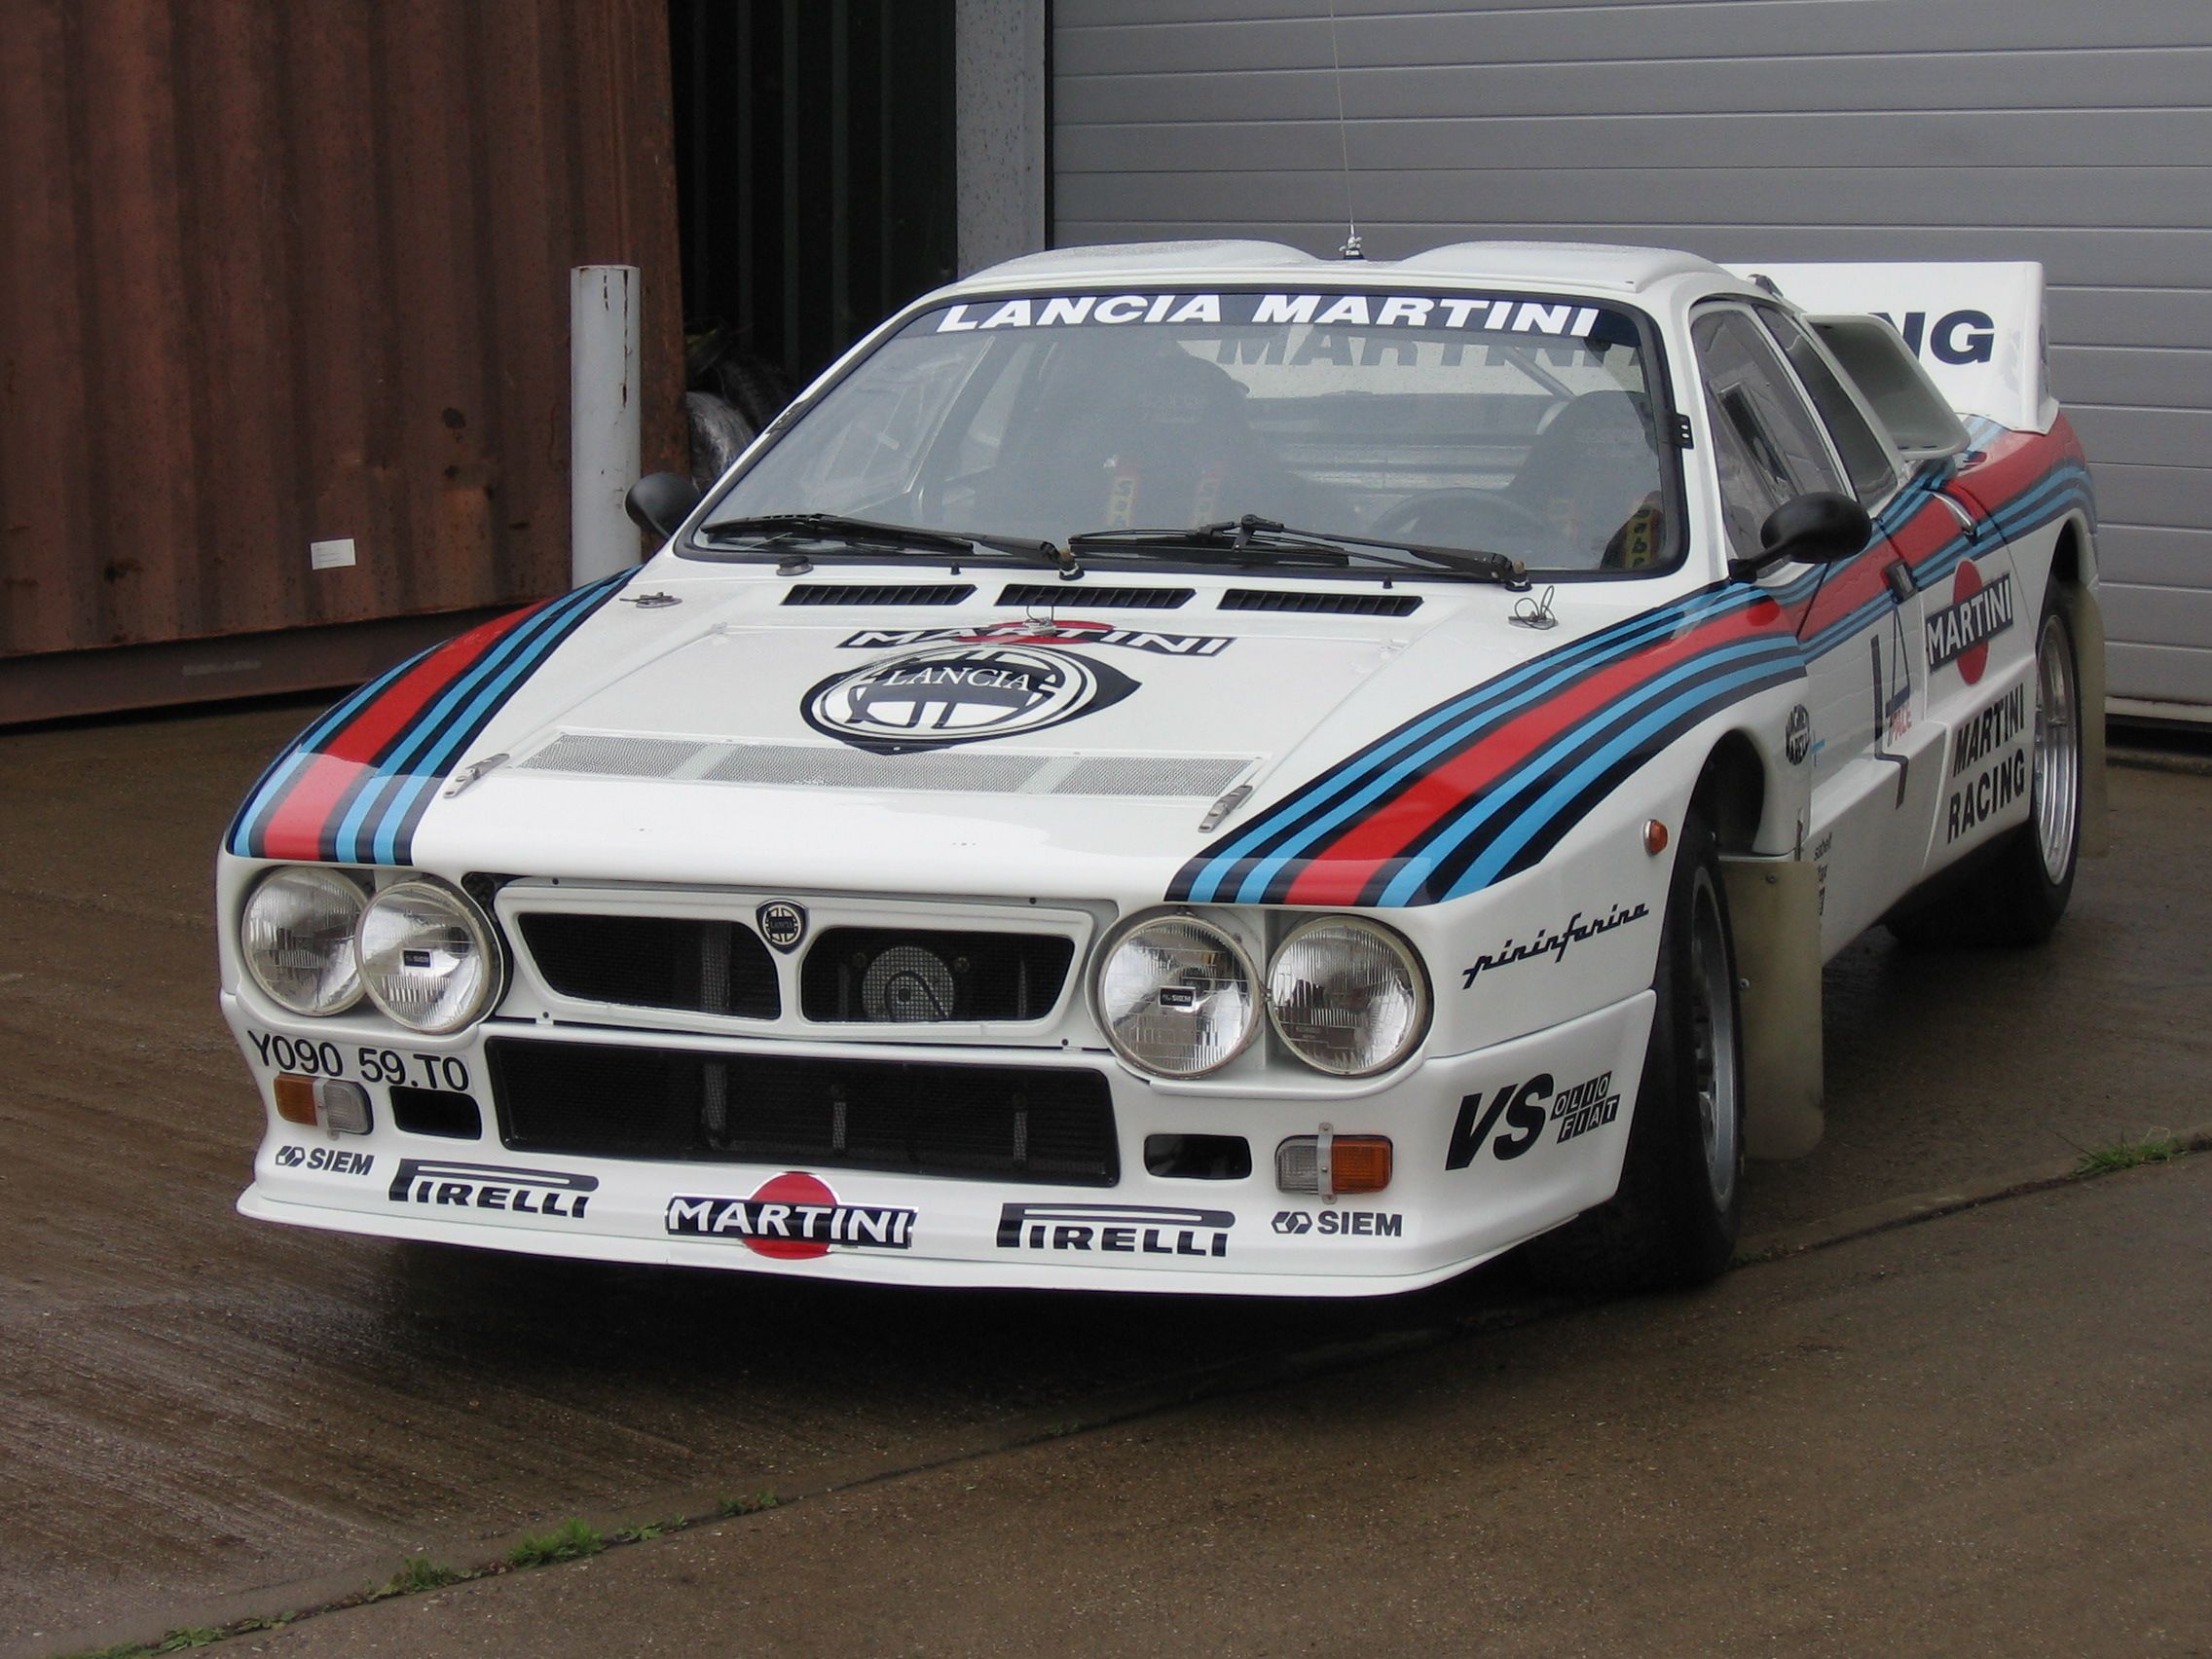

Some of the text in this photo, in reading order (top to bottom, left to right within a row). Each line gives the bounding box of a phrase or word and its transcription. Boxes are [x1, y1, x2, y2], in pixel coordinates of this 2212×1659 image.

[936, 294, 1602, 338] LANCIA MARTINI
[843, 626, 1234, 654] MARTINI
[1926, 575, 2012, 665] MARTINI
[882, 666, 1034, 691] LANCIA
[1952, 682, 2025, 777] MARTINI
[1948, 749, 2025, 843] RACING
[1462, 903, 1649, 989] pininfarina
[1553, 1074, 1610, 1118] OLIO
[1560, 1097, 1618, 1140] FIAT
[1445, 1073, 1554, 1171] VS
[306, 1147, 376, 1176] SIEM
[388, 1158, 600, 1219] PIRELLI
[668, 1198, 909, 1244] MARTINI
[996, 1202, 1235, 1257] PIRELLI
[1317, 1210, 1402, 1237] SIEM
